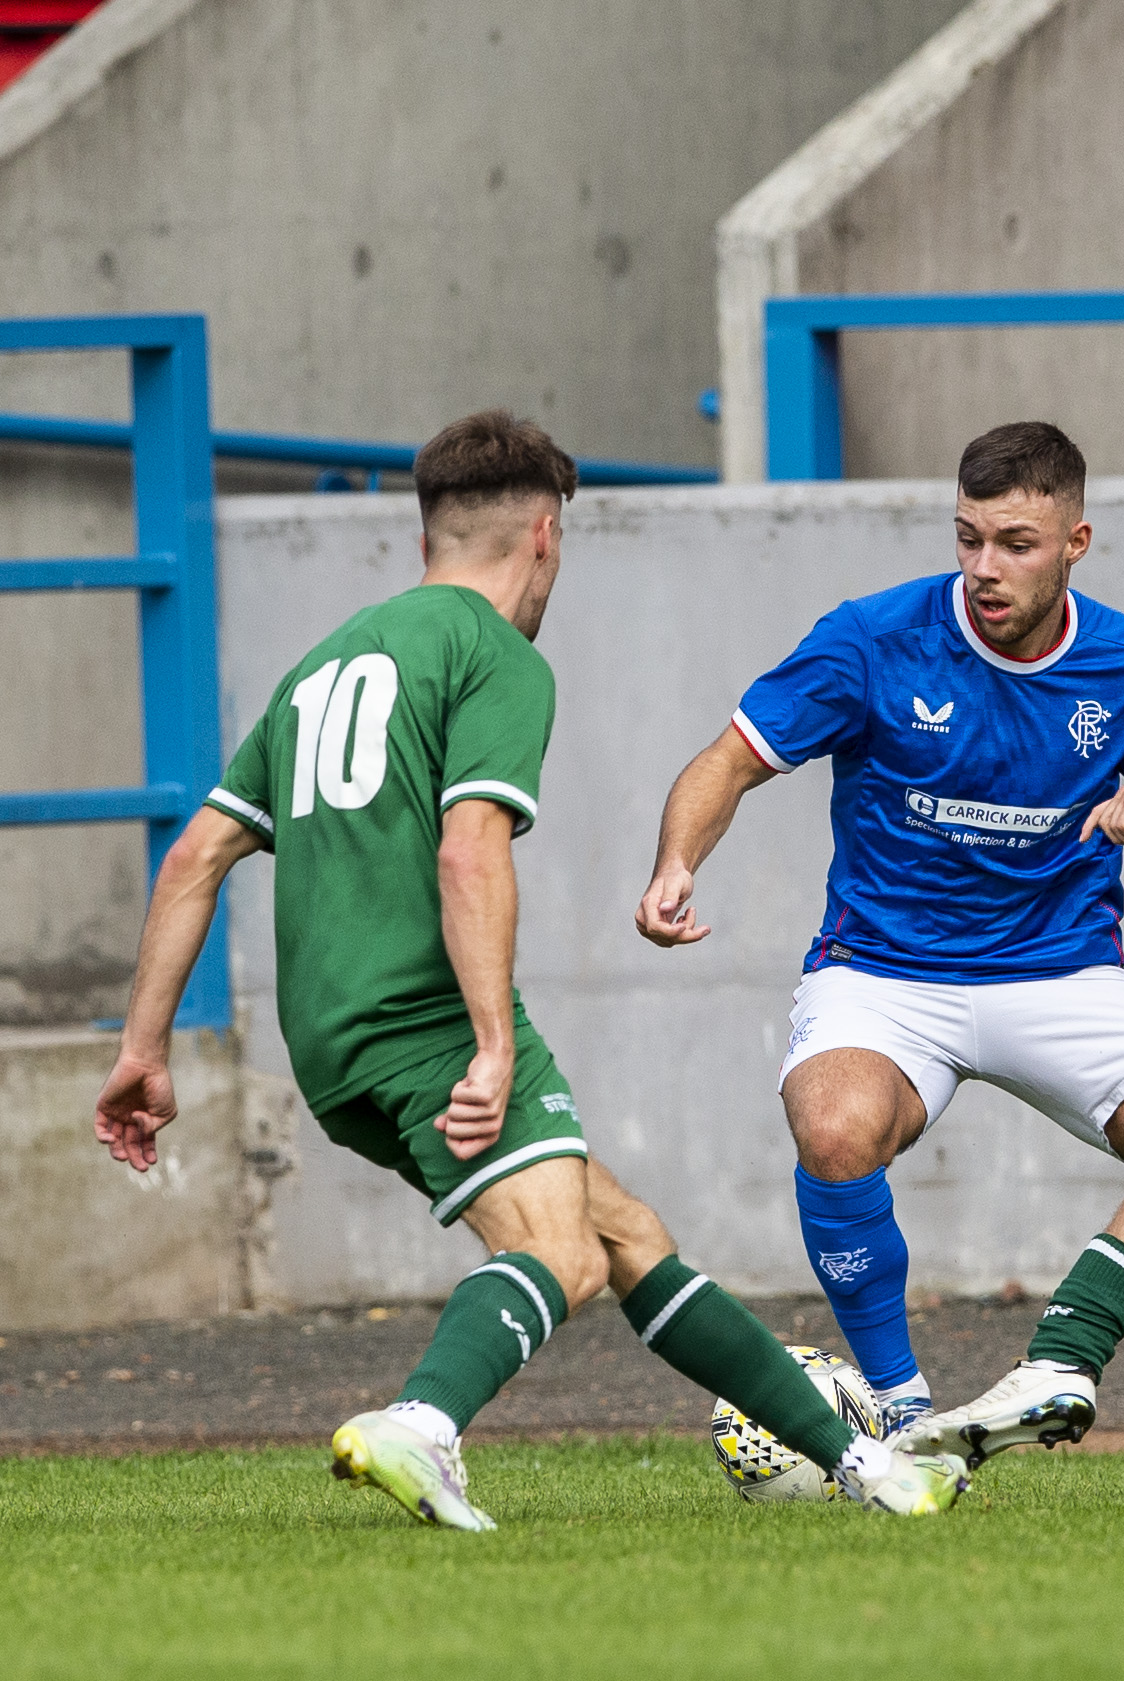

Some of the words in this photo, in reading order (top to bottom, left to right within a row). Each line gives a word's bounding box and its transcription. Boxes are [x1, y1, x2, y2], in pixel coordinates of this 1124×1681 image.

[290, 652, 399, 819] 10
[946, 805, 1010, 825] CARRICK
[951, 831, 962, 843] in
[962, 832, 1006, 847] Injection
[1006, 837, 1016, 848] &
